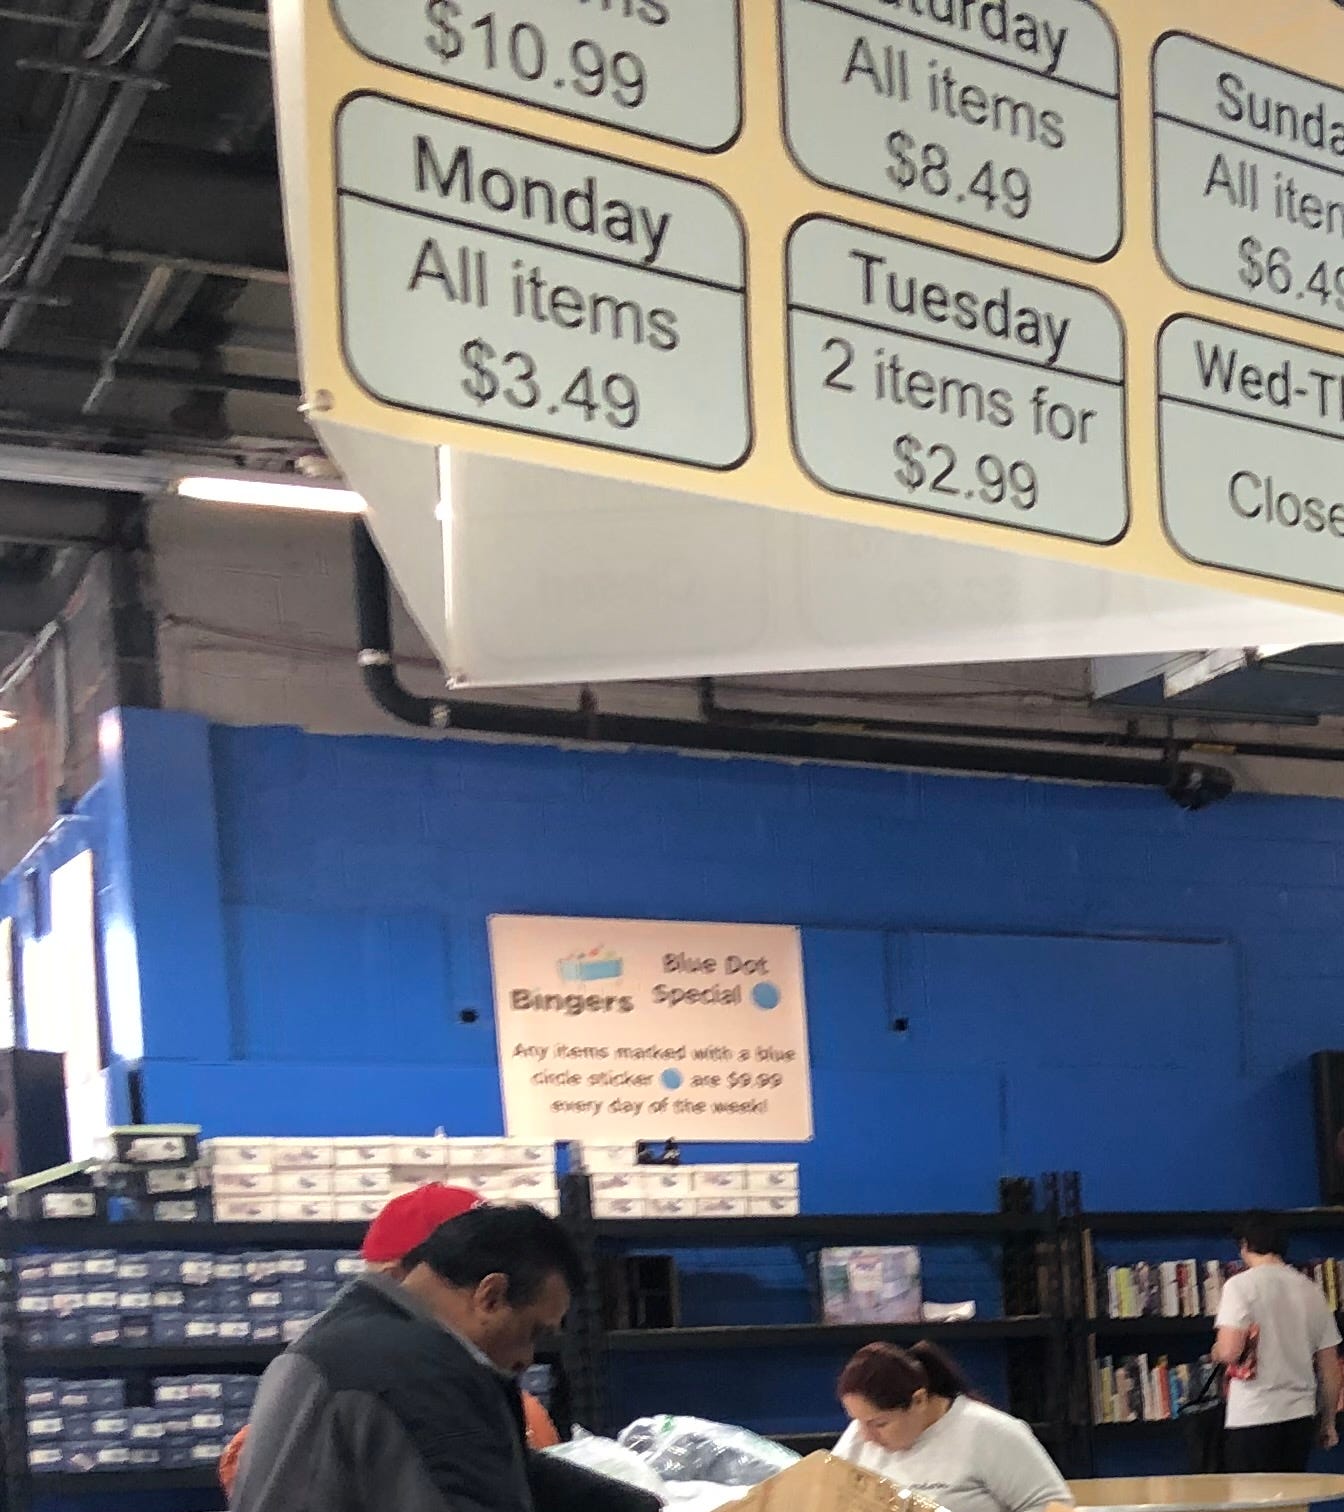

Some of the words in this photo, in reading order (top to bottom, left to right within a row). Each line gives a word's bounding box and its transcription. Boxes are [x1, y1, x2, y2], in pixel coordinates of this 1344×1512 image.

[426, 0, 648, 108] $10.99
[879, 0, 1068, 76] turday
[844, 36, 910, 102] All
[927, 58, 1066, 150] items
[413, 134, 672, 263] Monday
[885, 130, 1032, 220] $8.49
[1204, 153, 1258, 210] All
[408, 237, 489, 311] All
[512, 252, 681, 354] items
[848, 249, 1070, 365] Tuesday
[460, 337, 642, 432] $3.49
[821, 337, 854, 396] 2
[872, 344, 1019, 437] items
[1028, 388, 1096, 449] for
[893, 433, 1039, 513] $2.99
[509, 988, 635, 1016] Bingers
[652, 983, 742, 1008] Special
[662, 952, 717, 975] Blue
[724, 954, 770, 975] Dot
[511, 1043, 548, 1062] Any
